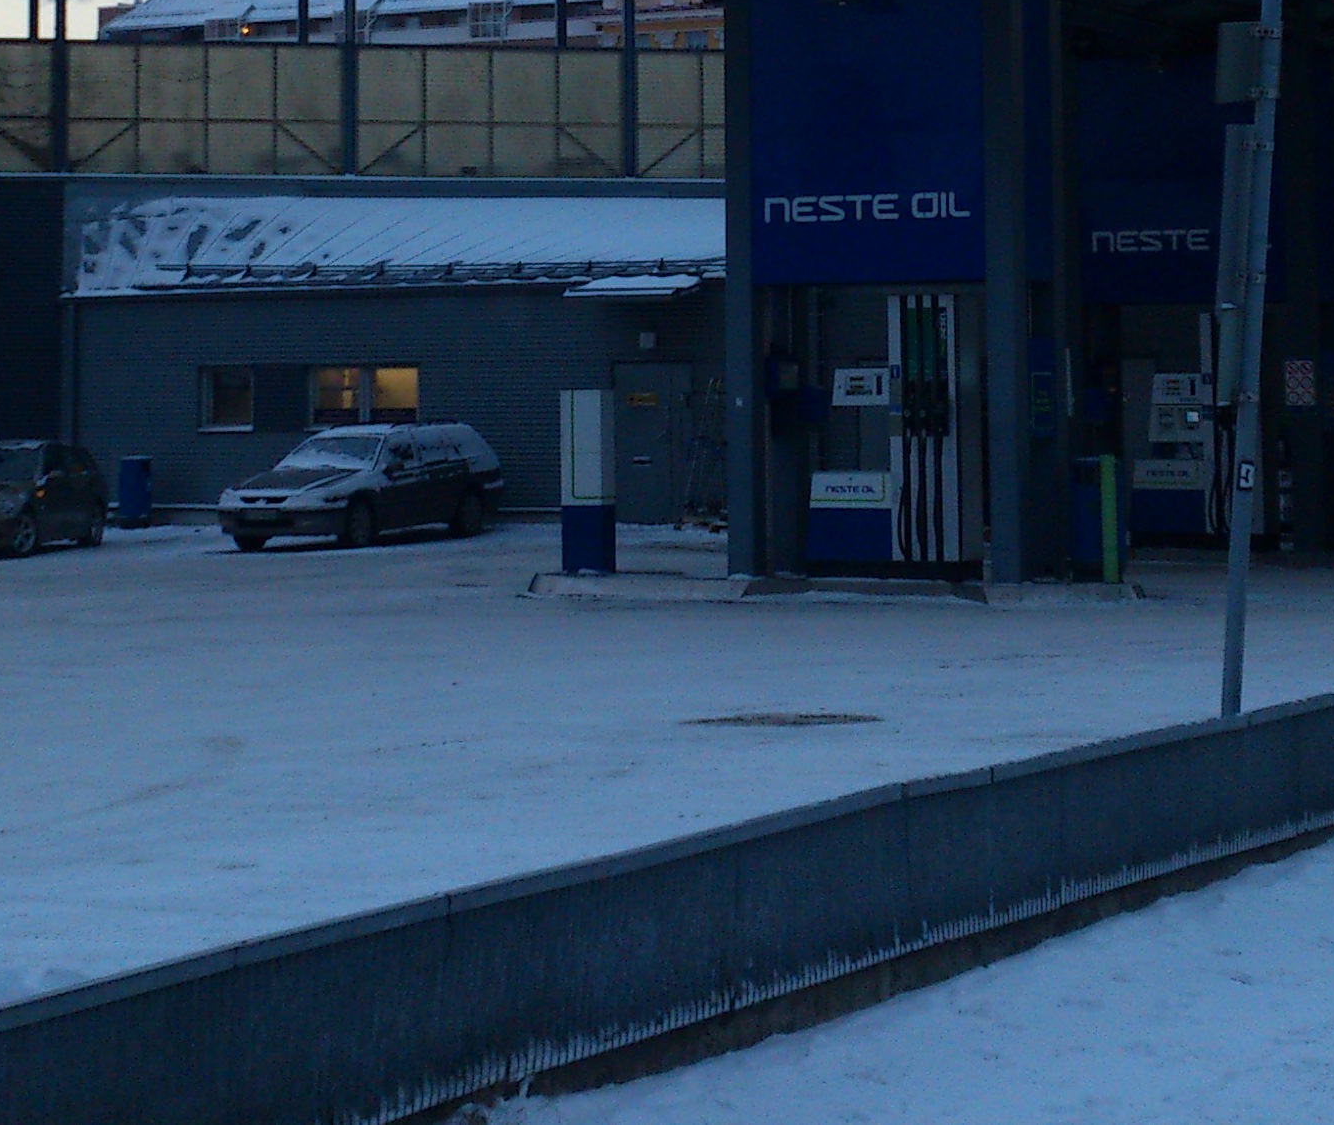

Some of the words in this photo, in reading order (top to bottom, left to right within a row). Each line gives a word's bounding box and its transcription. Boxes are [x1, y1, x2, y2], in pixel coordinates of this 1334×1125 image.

[763, 193, 900, 224] NESTE
[910, 190, 972, 219] OIL
[1090, 228, 1211, 253] NESTE
